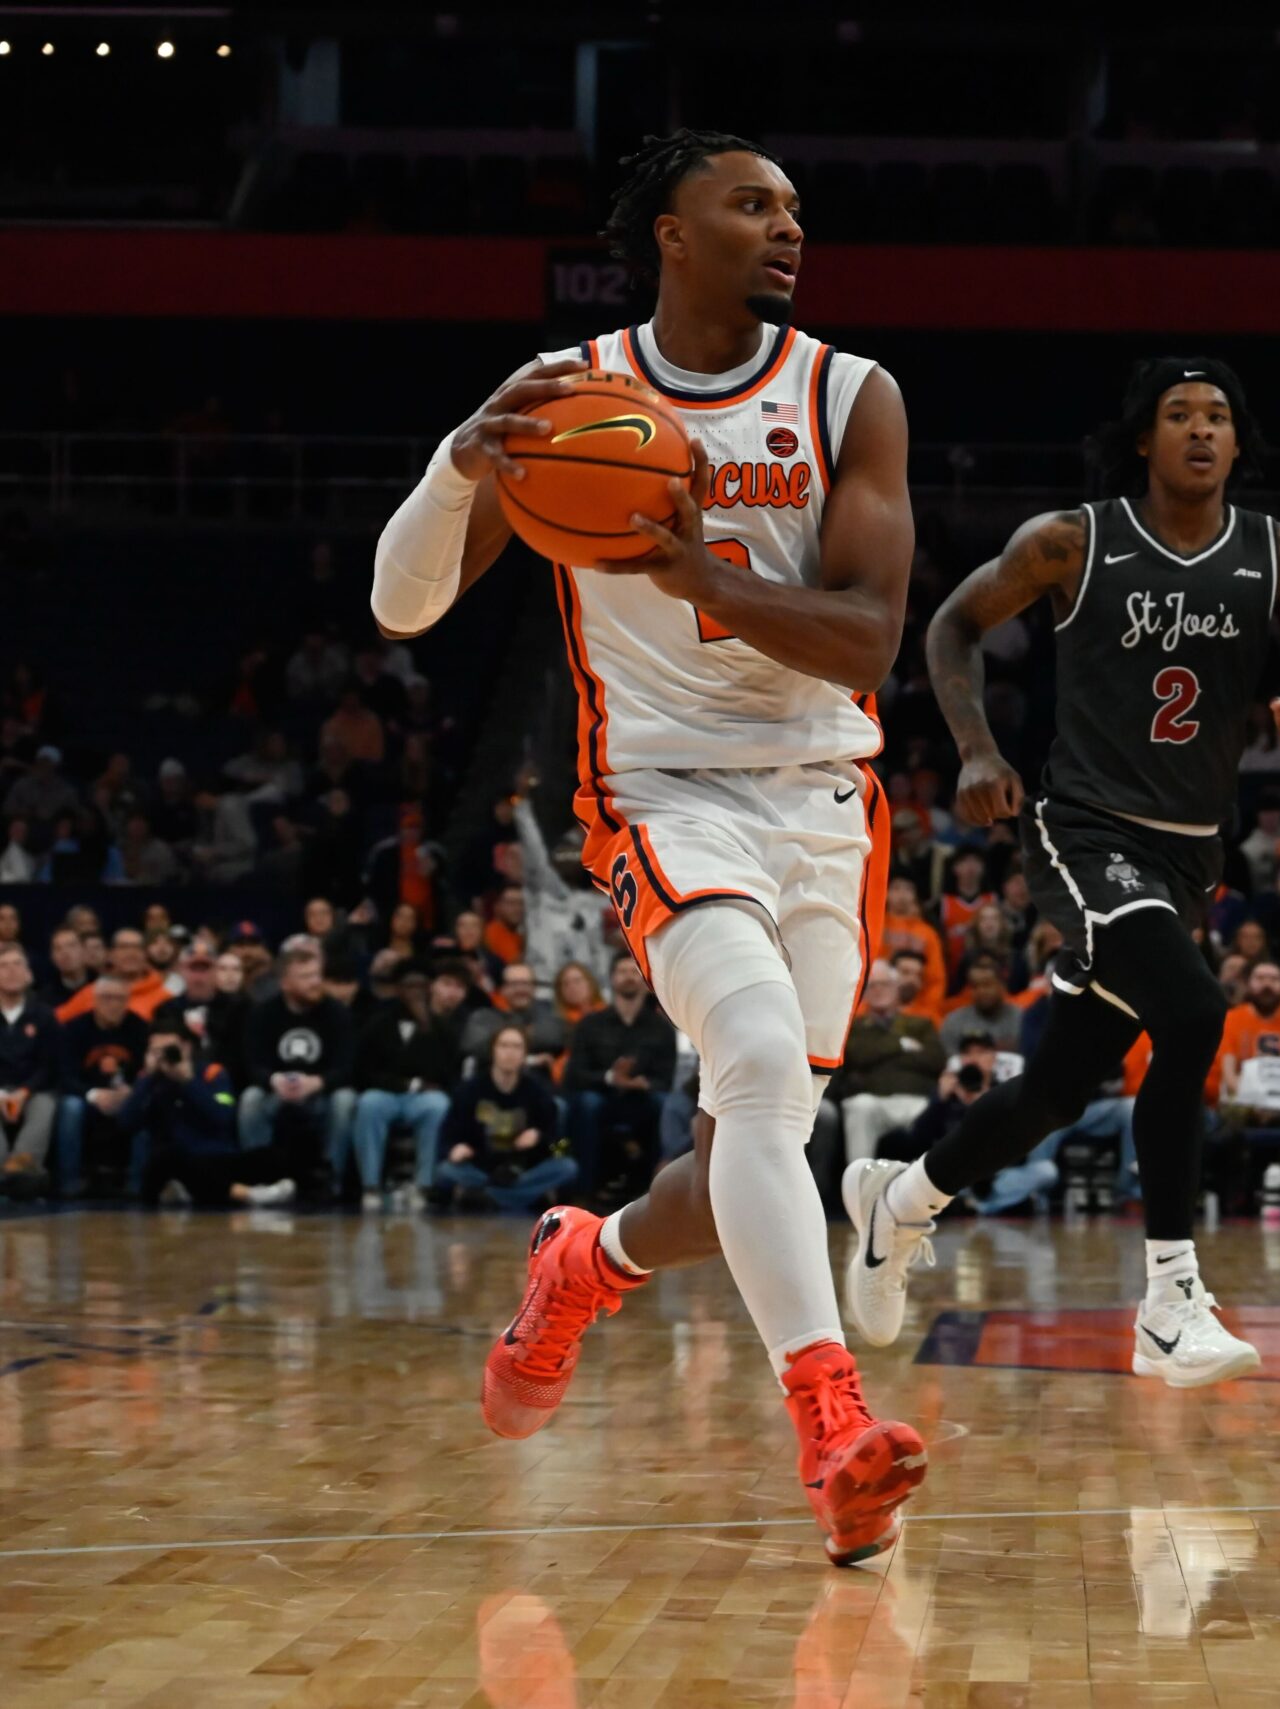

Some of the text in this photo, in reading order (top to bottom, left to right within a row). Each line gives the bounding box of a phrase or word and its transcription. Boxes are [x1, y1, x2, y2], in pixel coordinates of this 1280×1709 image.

[553, 262, 628, 304] 102
[702, 461, 811, 510] cuse
[1150, 665, 1202, 745] 2
[611, 852, 638, 930] S
